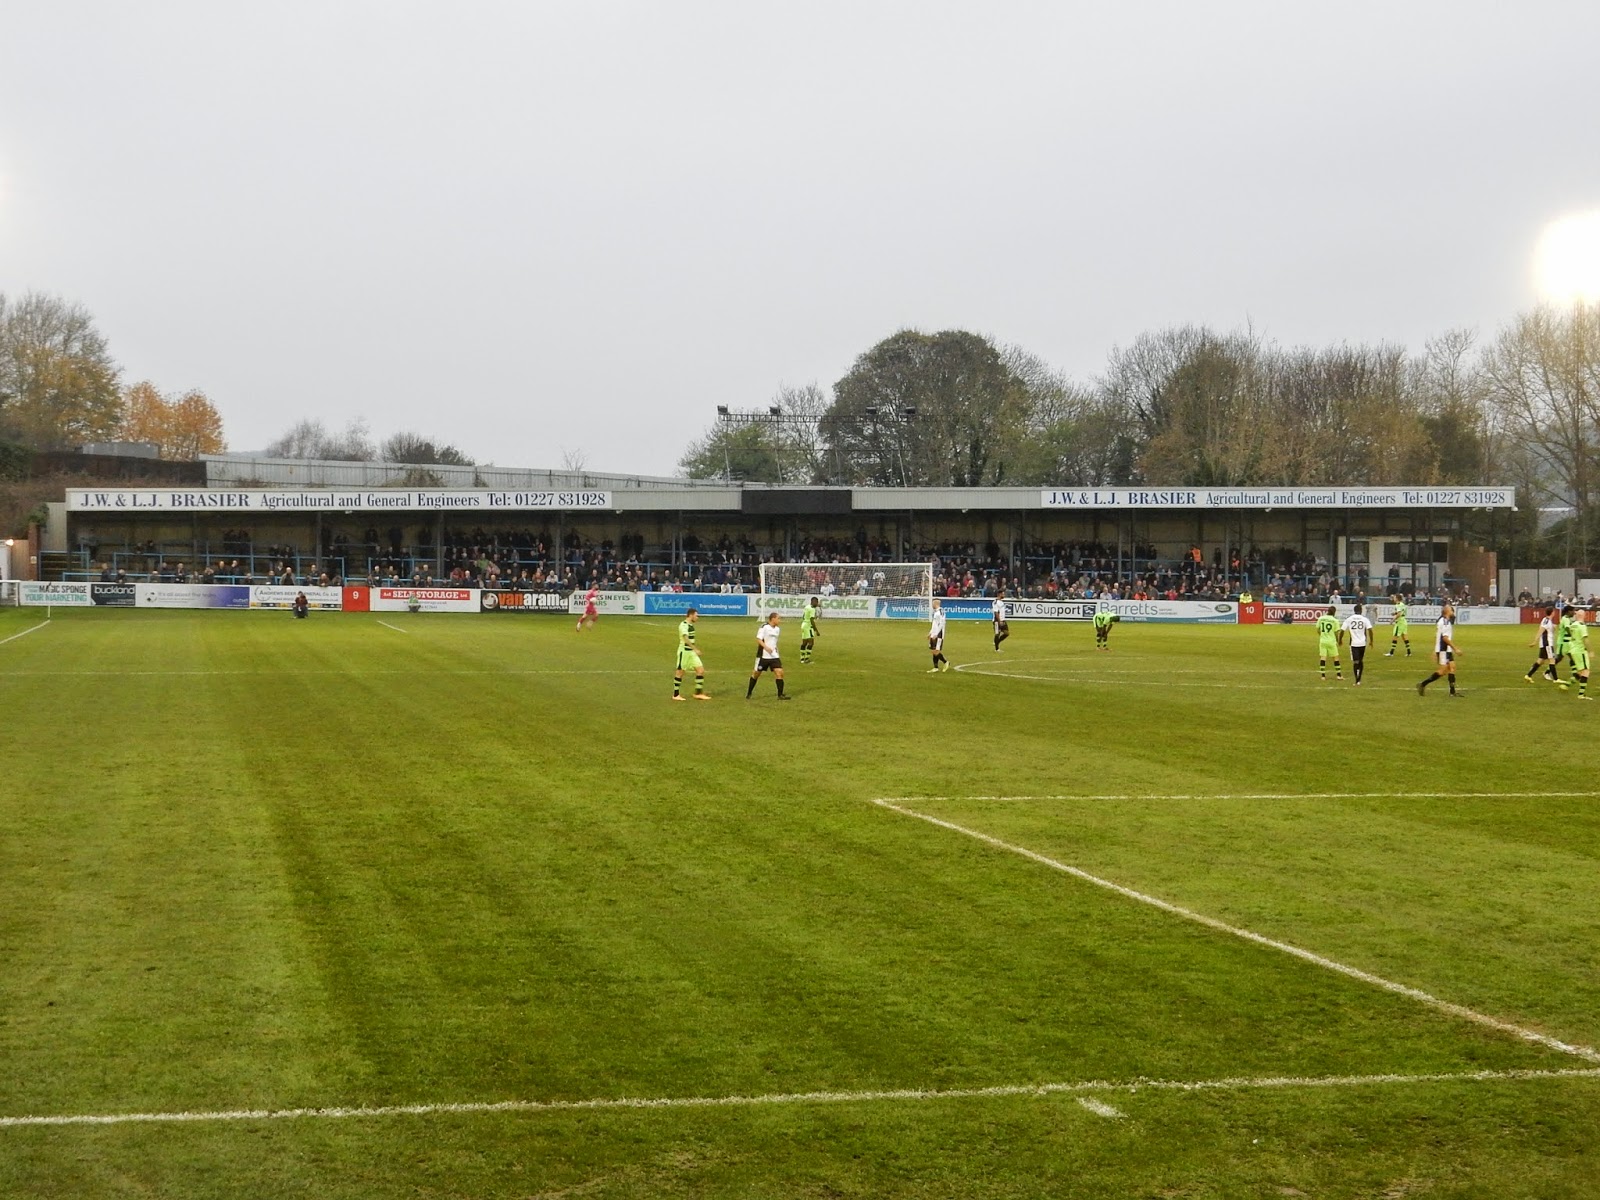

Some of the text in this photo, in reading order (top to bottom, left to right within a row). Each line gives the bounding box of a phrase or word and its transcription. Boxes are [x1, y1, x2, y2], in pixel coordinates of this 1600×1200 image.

[81, 493, 606, 510] J.W. & L.J. BRASIER Agricultural and General Engineers Tel: 01227 831928
[1049, 492, 1505, 506] J.W. & L.J. BRASIER Agricultural and General Engineers Tel: 01227 831928
[61, 585, 87, 593] SPONGE
[94, 585, 135, 594] buckland
[353, 590, 359, 599] 9
[415, 590, 459, 599] STORAGE
[25, 593, 88, 602] YOUR MARKETING
[498, 593, 568, 606] vanarama
[649, 596, 692, 610] Viridor
[820, 598, 868, 610] GOMEZ
[1014, 603, 1081, 616] We Support
[1100, 602, 1158, 615] Barretts
[1245, 606, 1255, 614] 10
[1267, 609, 1329, 620] KINBROO
[1378, 606, 1441, 617] HETAGE
[1321, 622, 1333, 633] 19
[1350, 620, 1364, 630] 28
